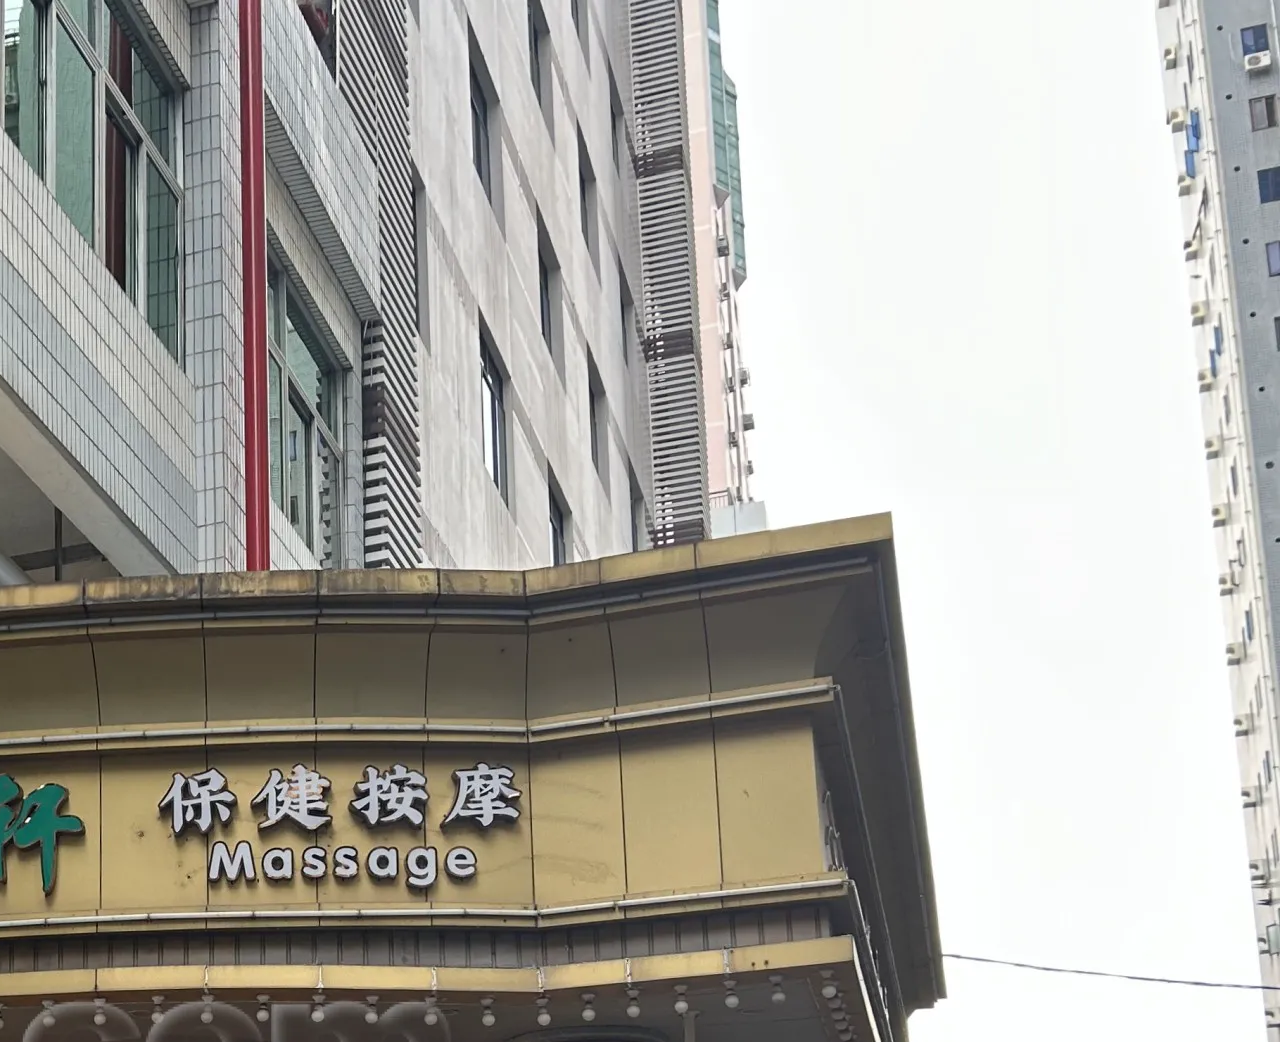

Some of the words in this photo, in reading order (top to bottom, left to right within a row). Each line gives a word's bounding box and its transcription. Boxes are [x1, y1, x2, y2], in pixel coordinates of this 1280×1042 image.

[158, 762, 522, 835] 保健按摩
[207, 840, 478, 888] Massage
